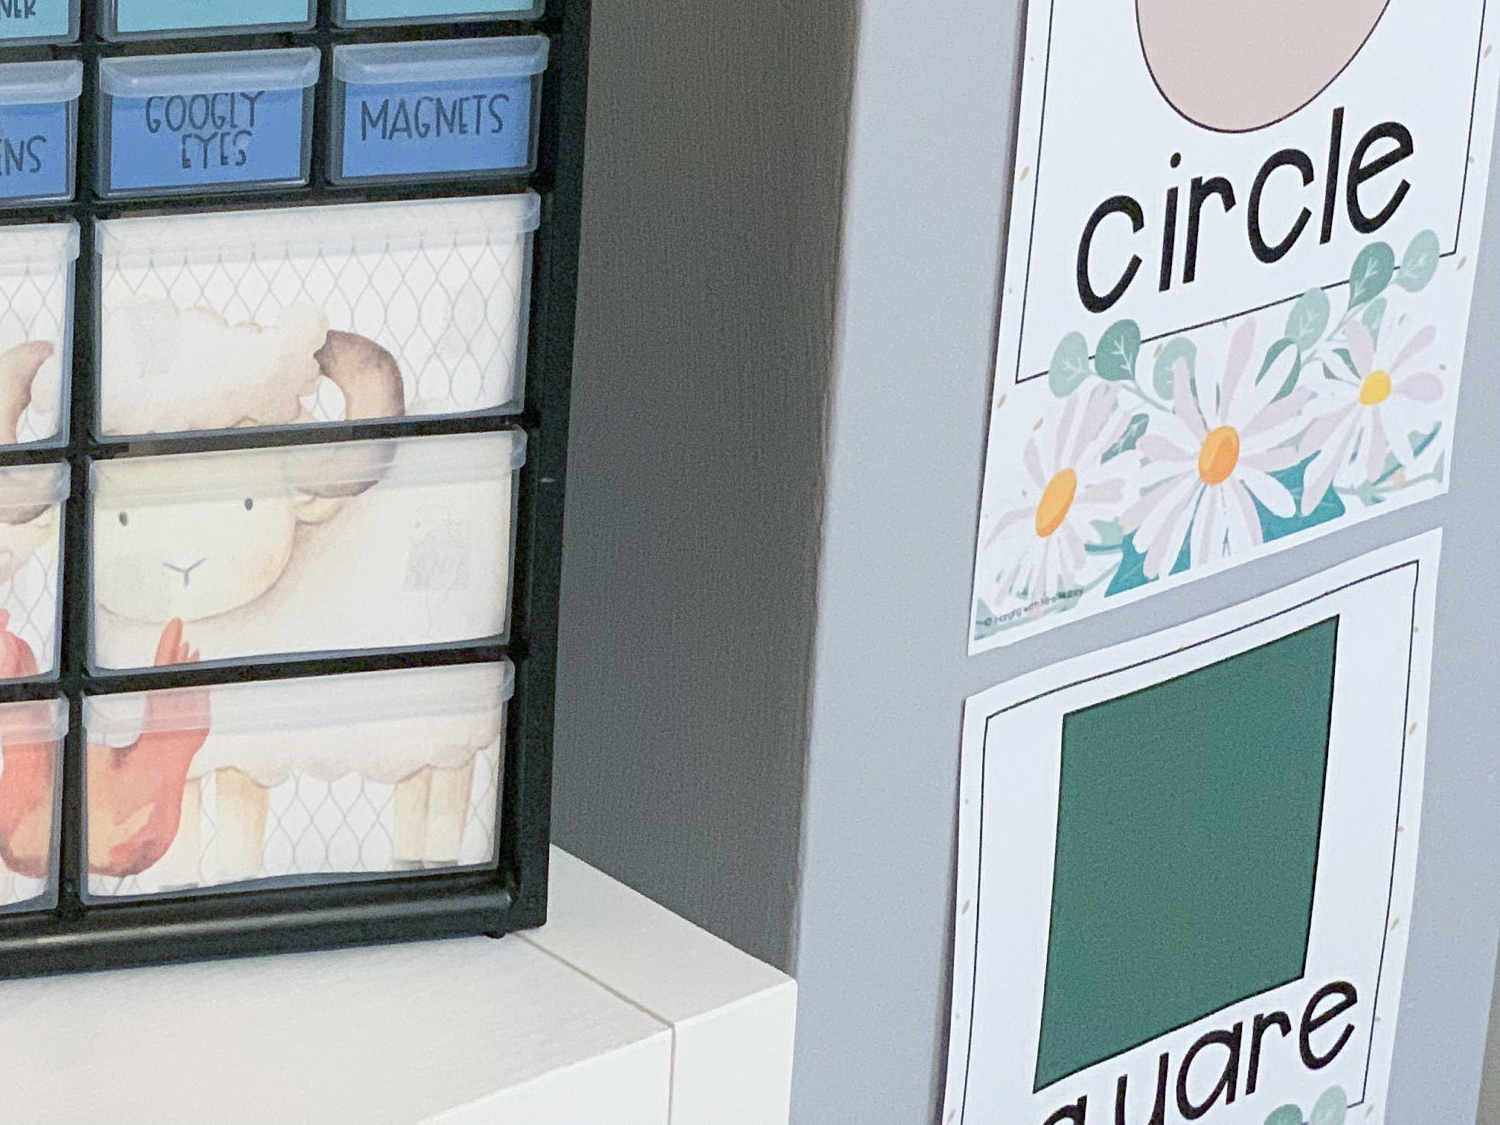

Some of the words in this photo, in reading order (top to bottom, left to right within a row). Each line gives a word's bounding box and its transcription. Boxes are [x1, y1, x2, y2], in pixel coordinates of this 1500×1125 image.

[146, 90, 265, 134] GOOGLY
[360, 93, 510, 141] MAGNETS
[180, 130, 254, 170] EYES
[1076, 107, 1414, 313] circle
